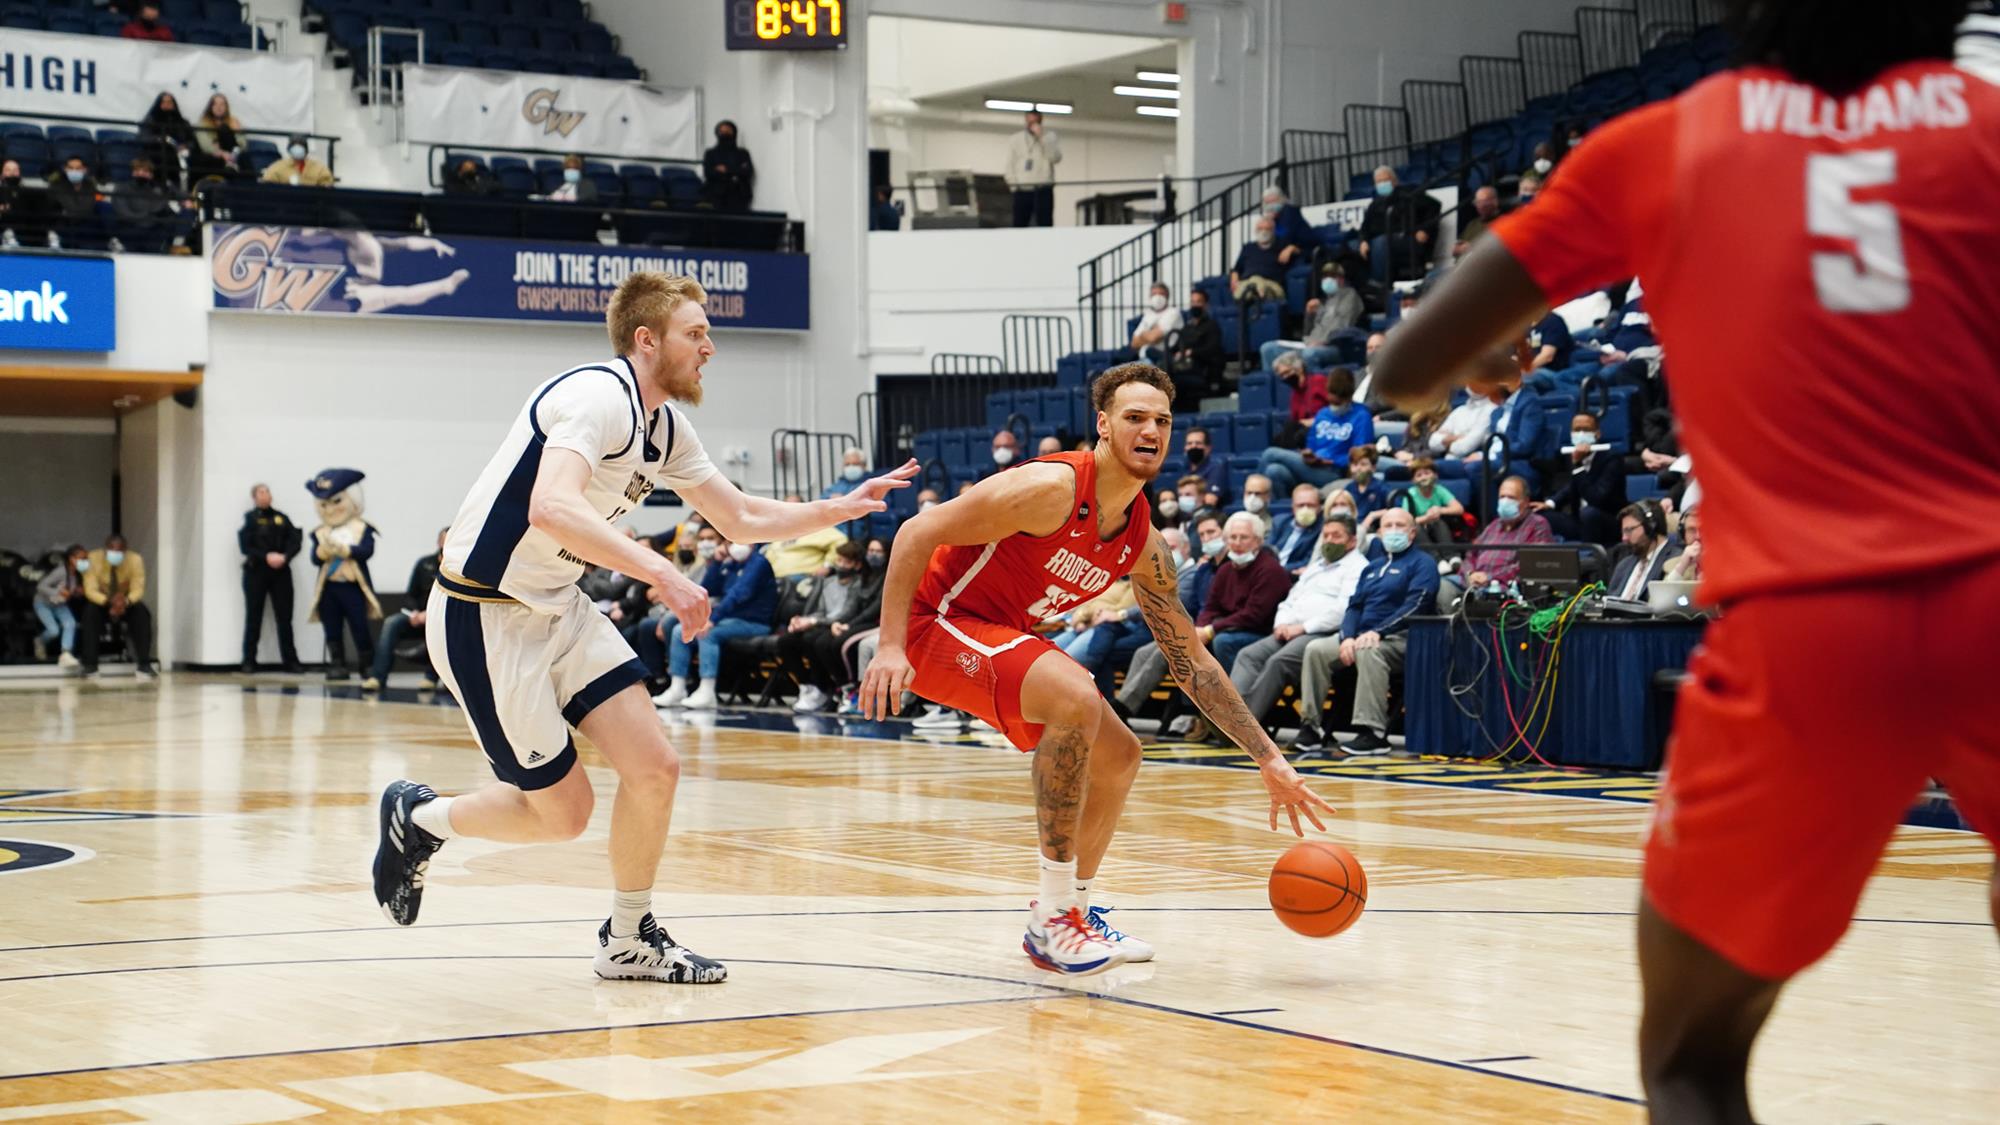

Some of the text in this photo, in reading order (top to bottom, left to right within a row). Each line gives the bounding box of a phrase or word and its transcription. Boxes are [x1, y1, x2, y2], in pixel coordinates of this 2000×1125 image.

[756, 0, 841, 39] 8:47
[0, 53, 96, 95] HIGH
[1739, 73, 1970, 143] WILLIAMS
[1326, 206, 1368, 225] SECT
[1807, 149, 1911, 314] 5
[513, 252, 556, 283] JOIN
[558, 254, 595, 285] THE
[701, 260, 748, 291] CLUB
